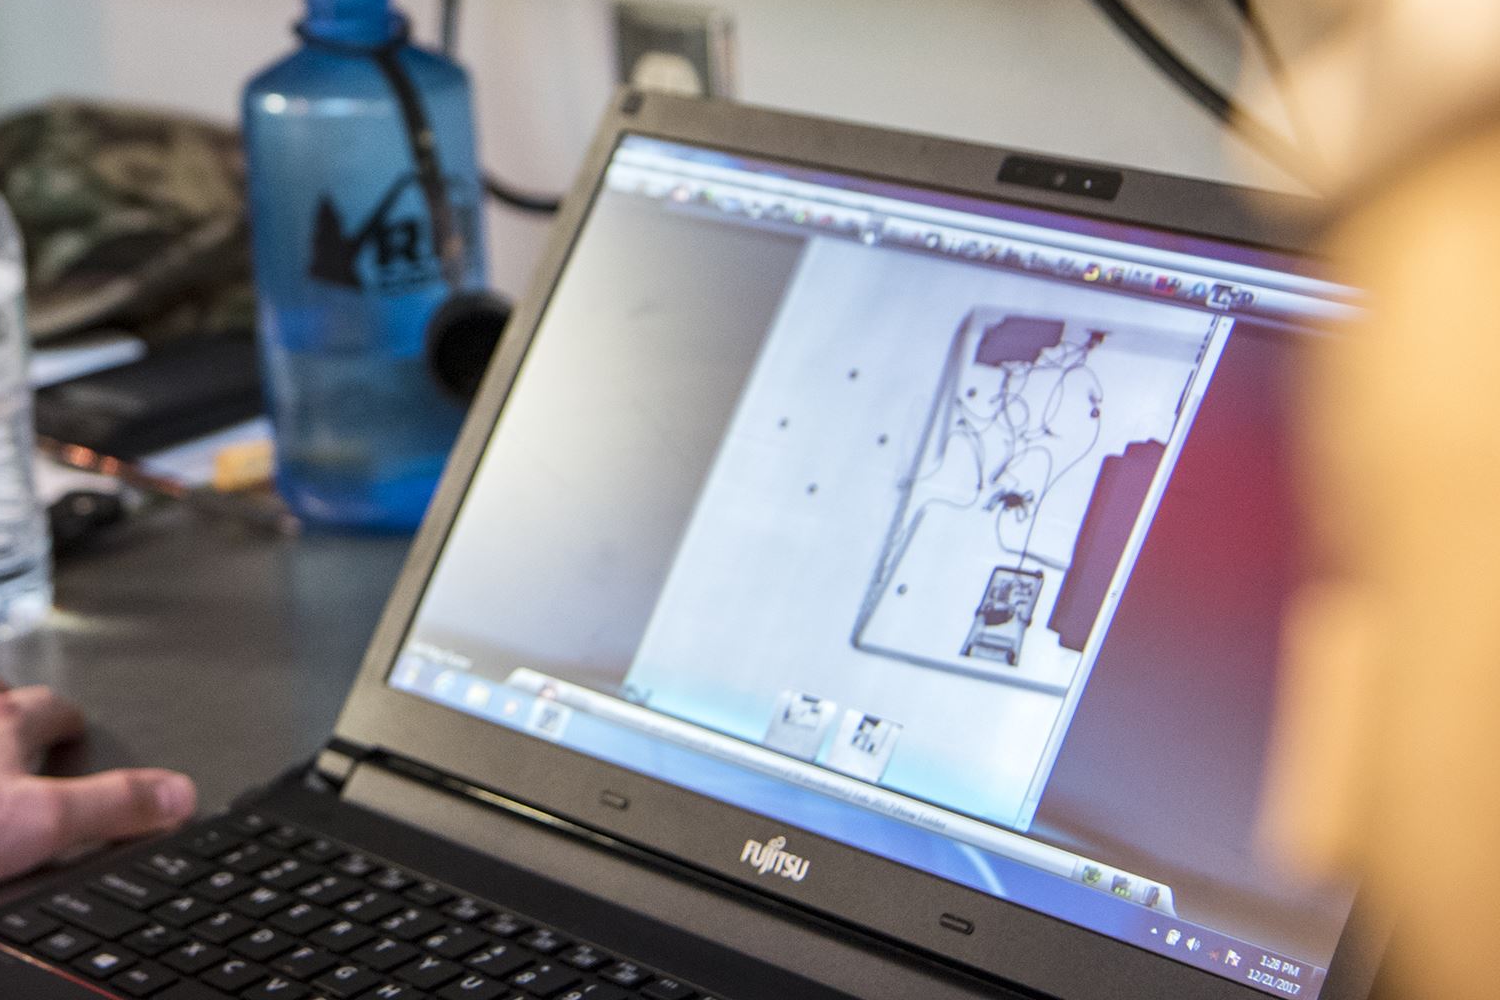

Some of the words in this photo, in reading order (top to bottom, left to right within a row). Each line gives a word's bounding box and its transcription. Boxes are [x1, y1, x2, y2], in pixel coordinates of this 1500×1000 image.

[740, 835, 810, 882] FUJITSU
[1246, 967, 1301, 995] 12/21/2017
[1281, 961, 1301, 977] PM
